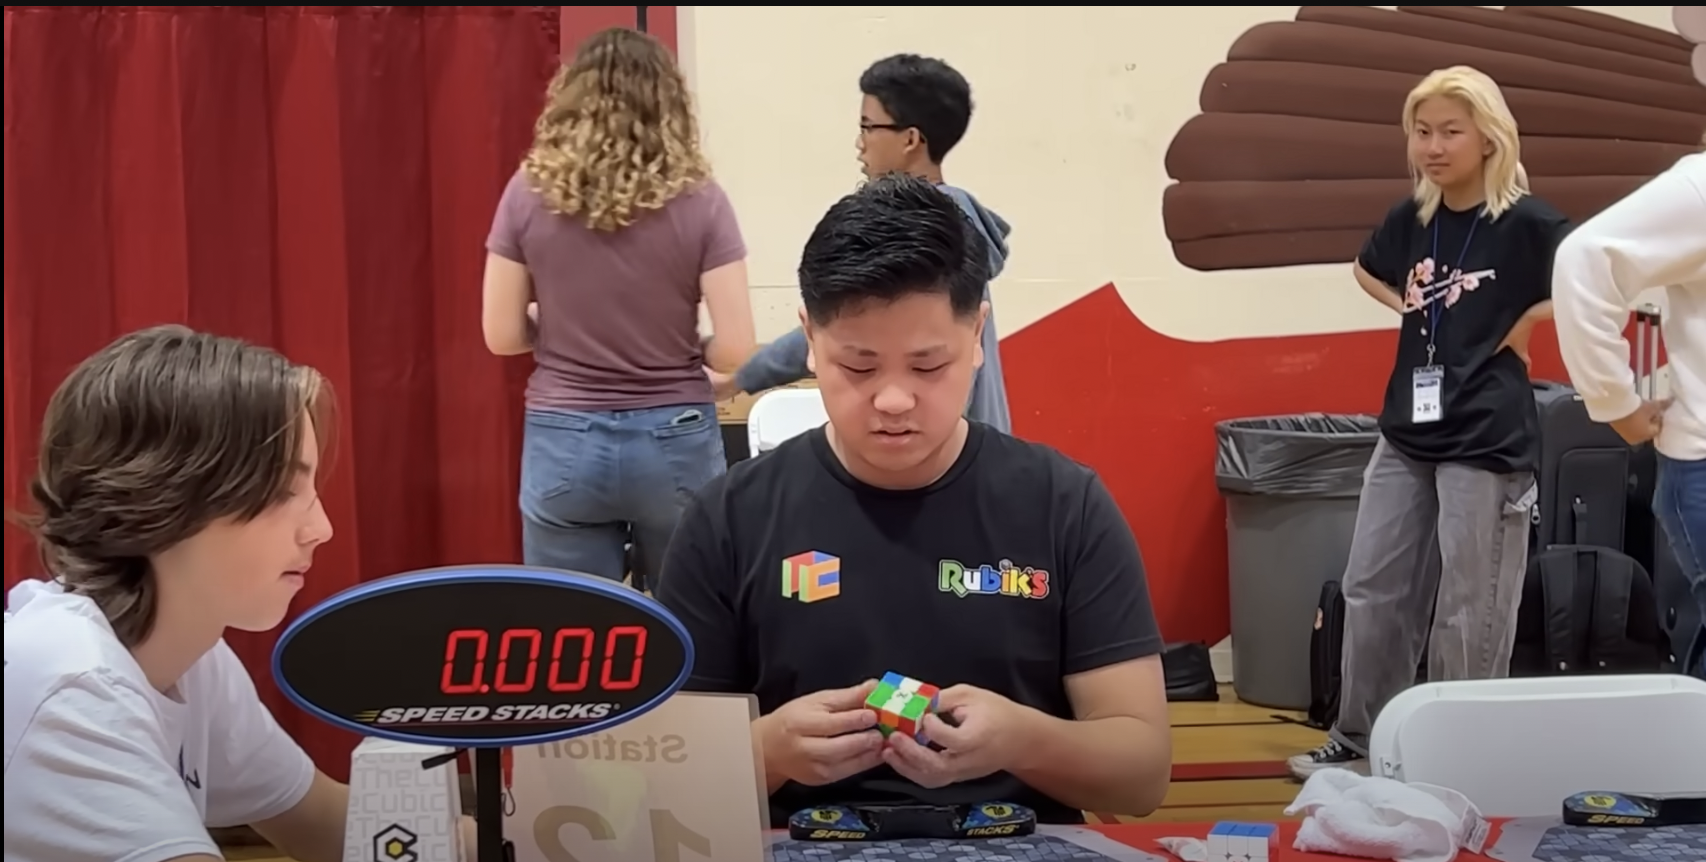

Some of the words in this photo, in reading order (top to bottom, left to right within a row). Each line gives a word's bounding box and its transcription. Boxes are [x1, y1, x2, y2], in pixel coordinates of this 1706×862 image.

[938, 558, 1049, 599] Rubik's
[440, 626, 648, 694] 0.000
[377, 706, 490, 723] SPEED
[1587, 814, 1645, 825] SPEED
[810, 829, 866, 839] SPEED
